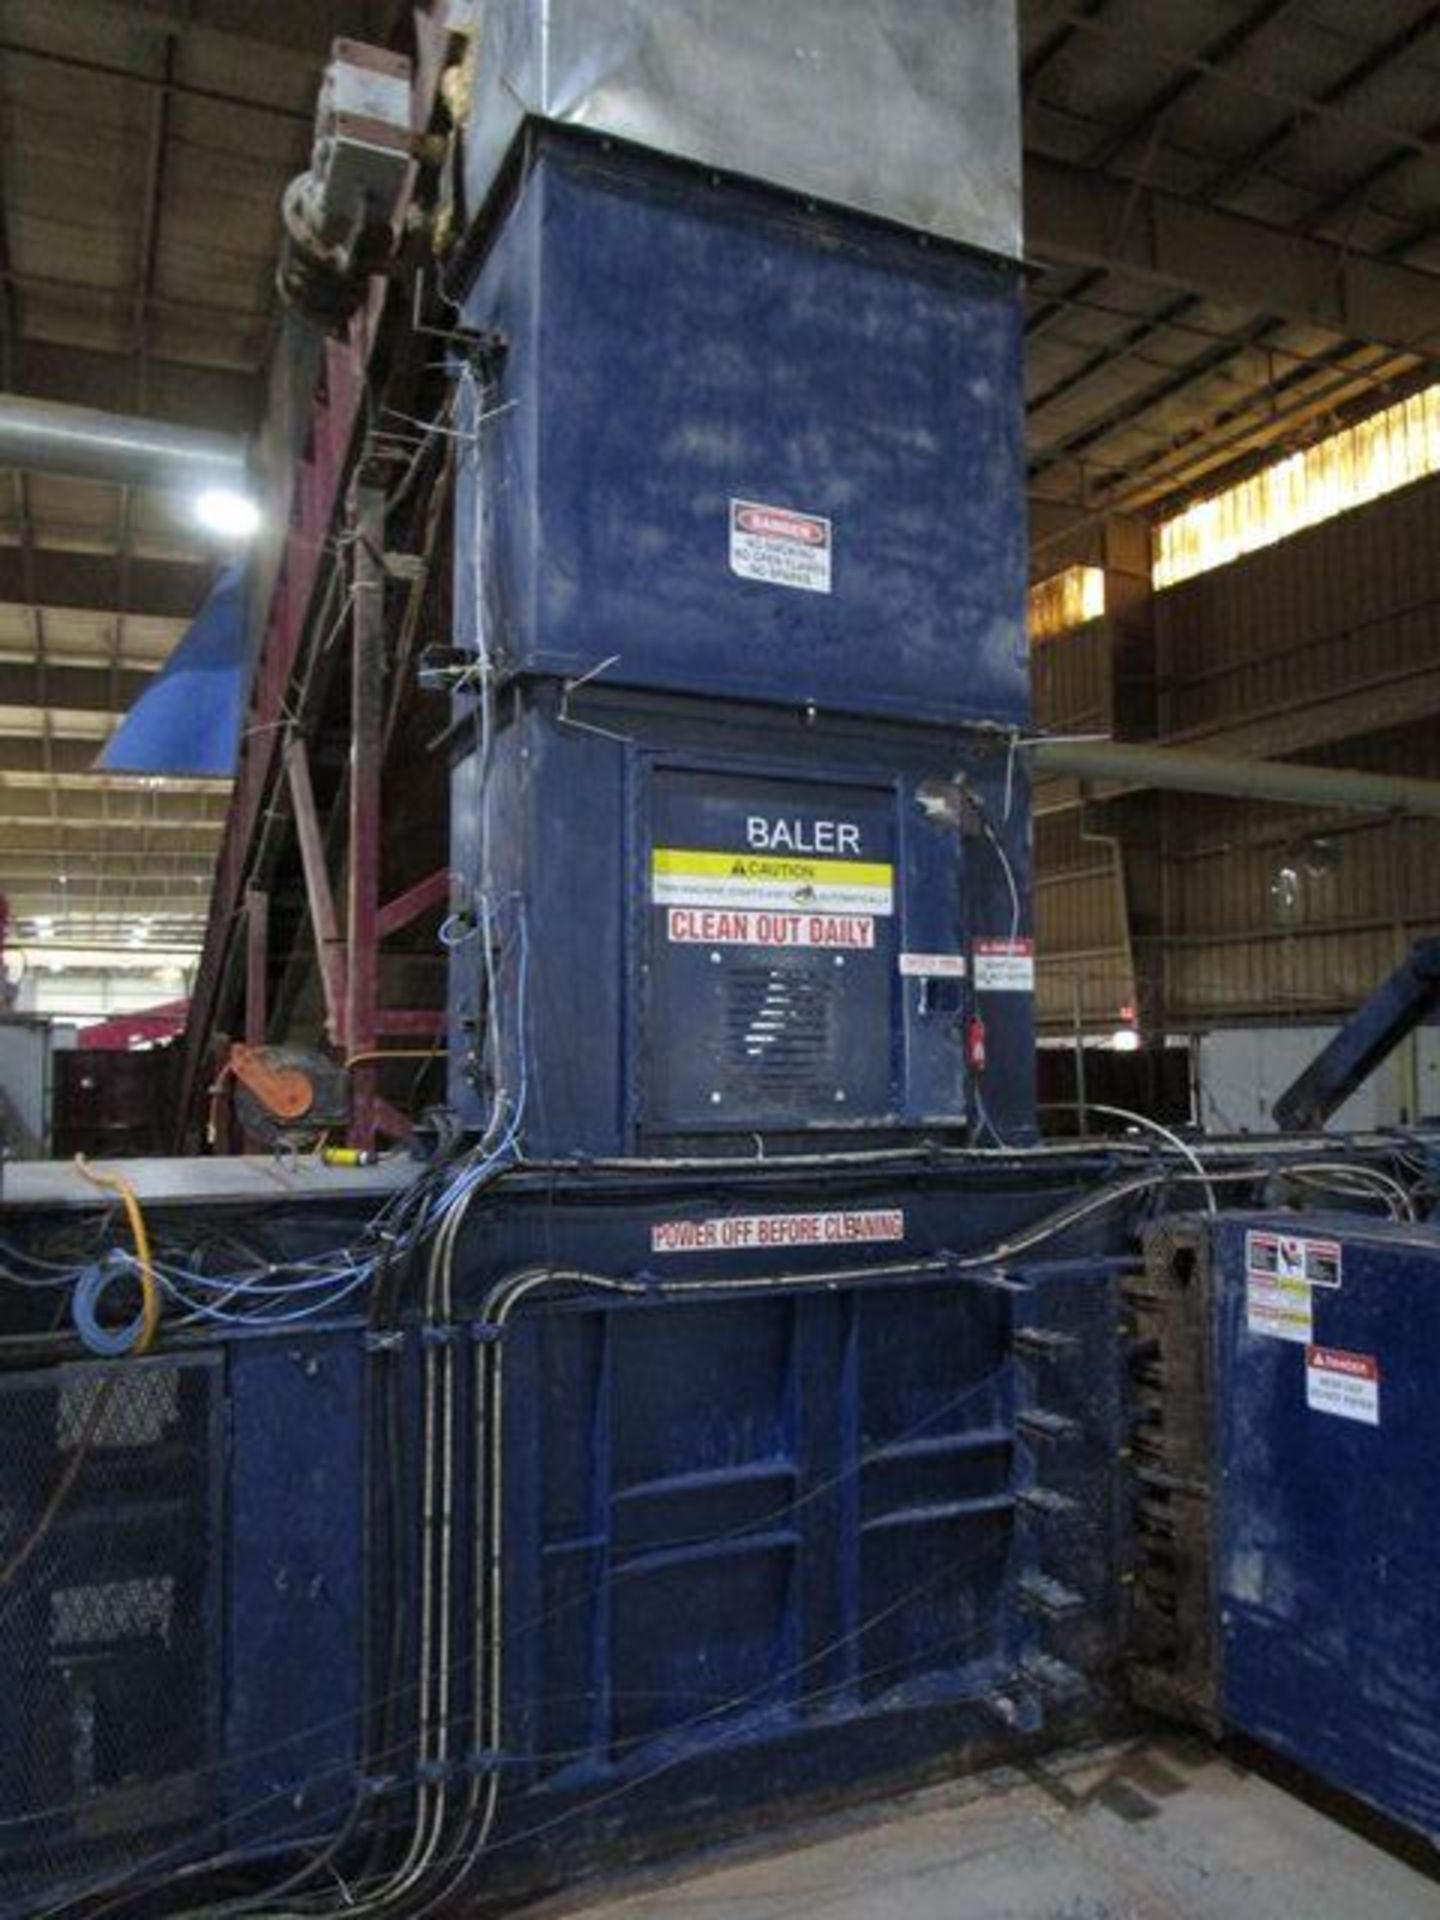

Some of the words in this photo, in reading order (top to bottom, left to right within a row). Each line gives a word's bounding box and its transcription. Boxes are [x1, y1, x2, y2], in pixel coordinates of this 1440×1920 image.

[748, 816, 861, 852] BALER
[749, 861, 816, 878] CAUTION
[671, 912, 748, 940] CLEAN
[756, 916, 802, 943] OUT
[809, 917, 872, 945] DAILY
[654, 1222, 718, 1247] POWER
[722, 1221, 753, 1243] OFF
[757, 1218, 821, 1242] BEFORE
[825, 1213, 900, 1239] CLEANING
